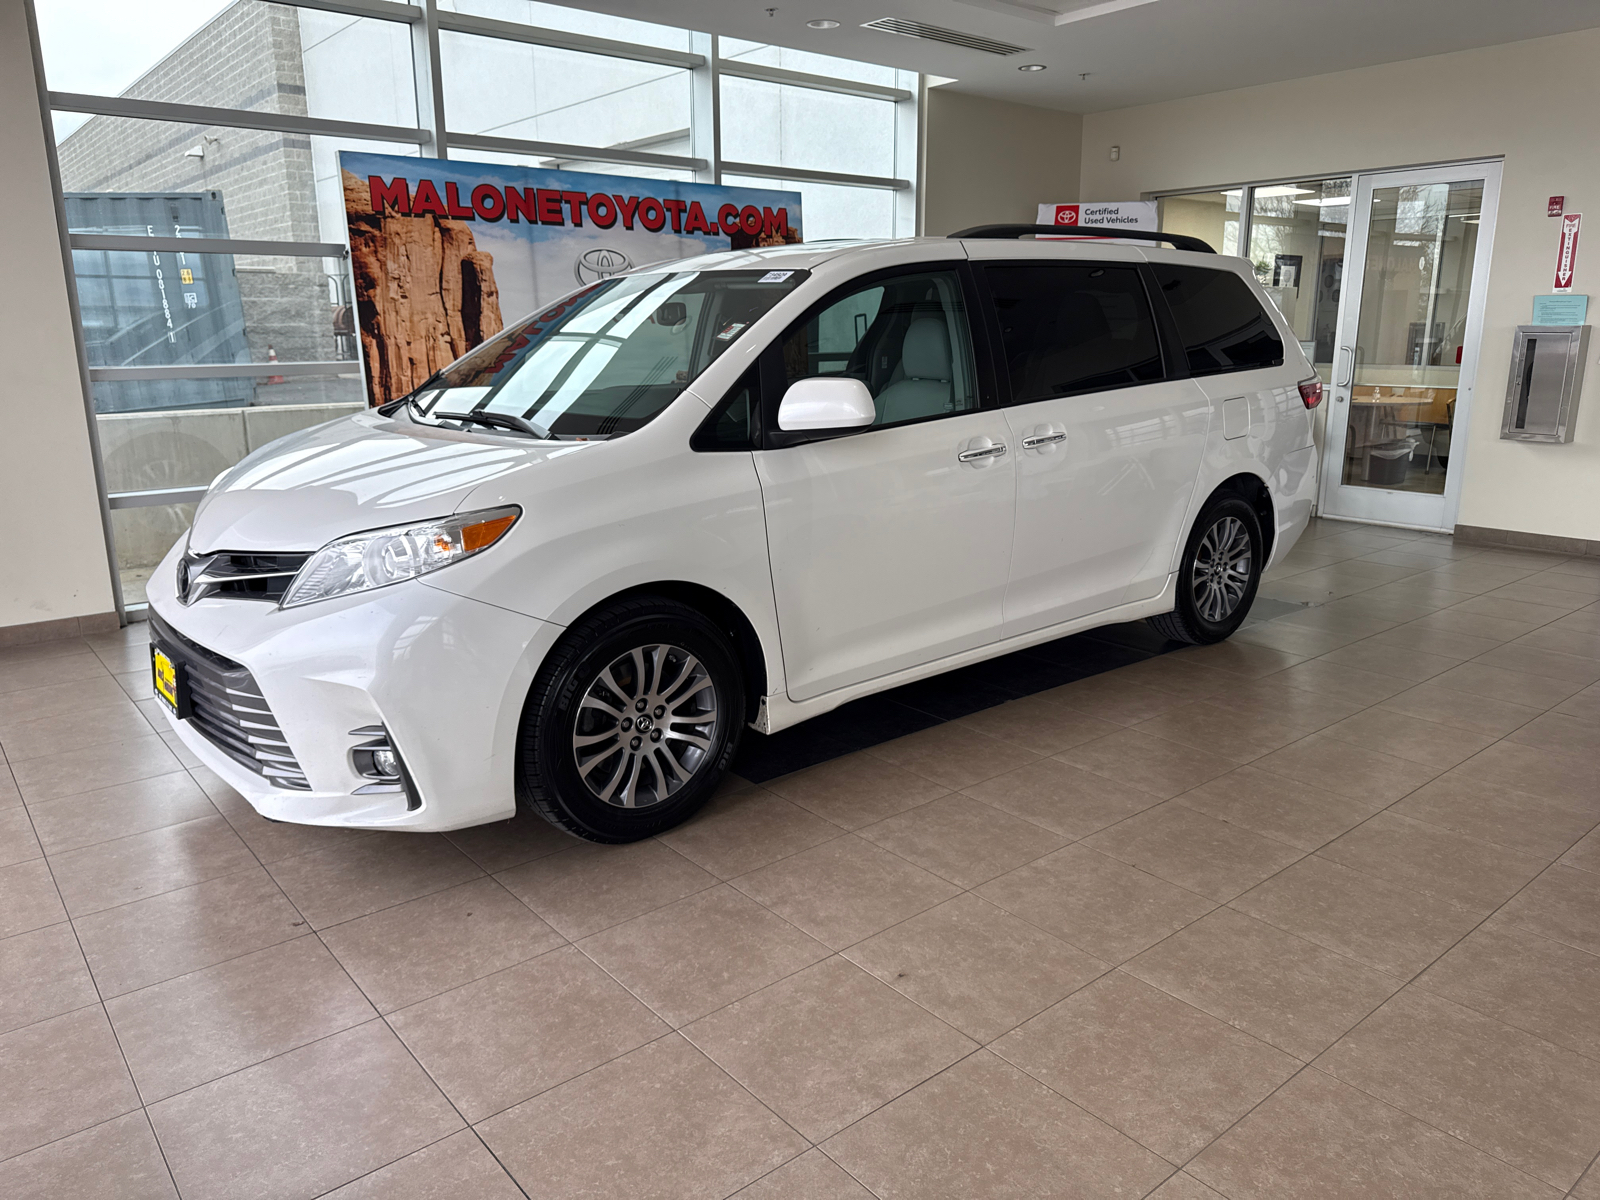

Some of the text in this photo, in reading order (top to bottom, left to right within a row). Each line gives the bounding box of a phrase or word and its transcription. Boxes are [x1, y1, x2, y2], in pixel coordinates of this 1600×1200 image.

[368, 175, 788, 237] MALONETOYOTA.COM
[1084, 207, 1119, 216] Certified
[1084, 216, 1138, 225] Used Vehicles
[1561, 228, 1573, 281] EXTINGUISHER
